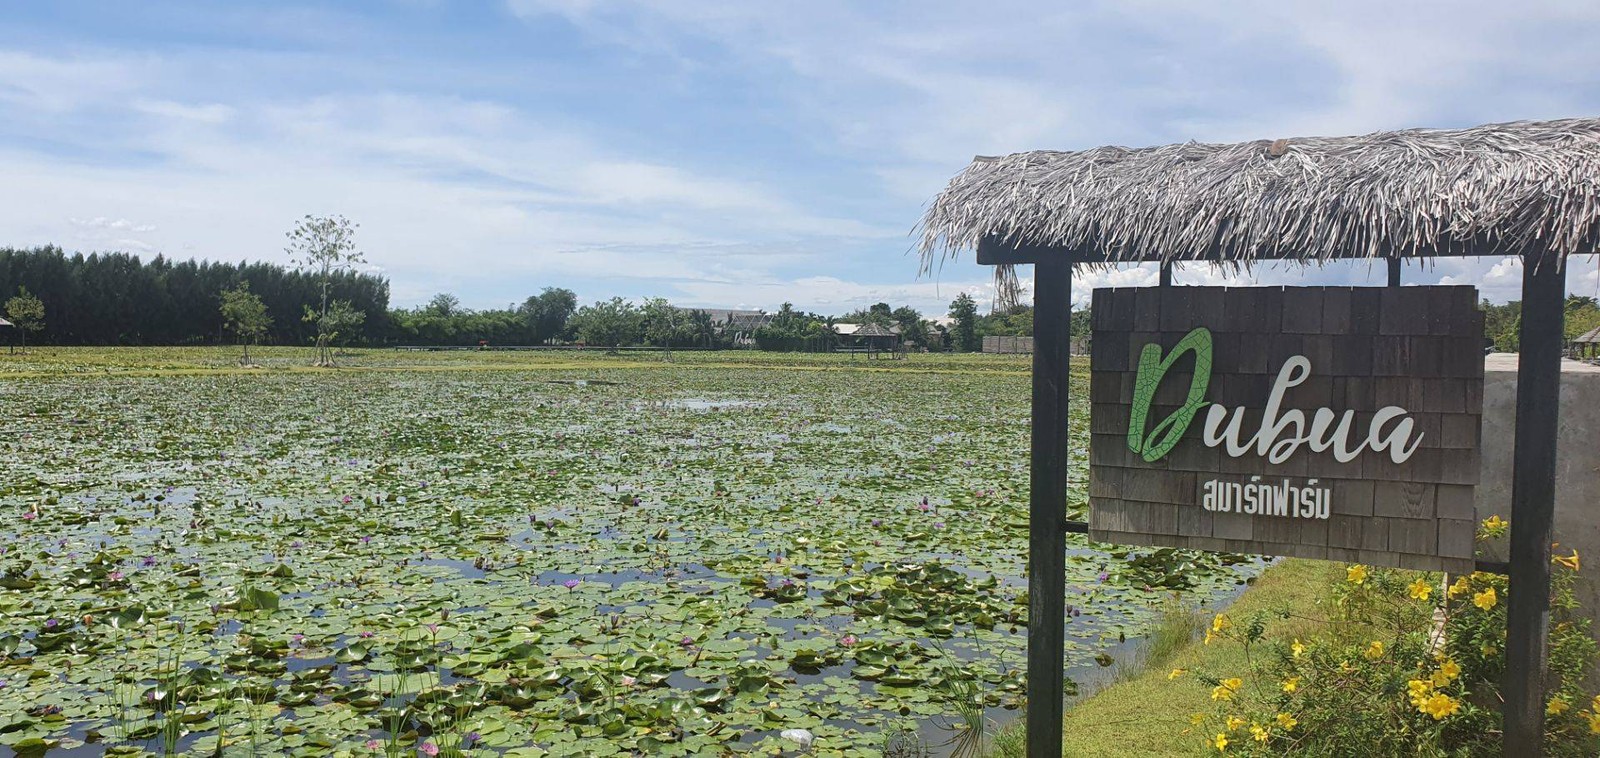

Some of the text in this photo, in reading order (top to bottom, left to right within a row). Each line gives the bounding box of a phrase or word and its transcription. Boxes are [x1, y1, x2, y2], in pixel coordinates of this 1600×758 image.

[1127, 327, 1424, 464] Dubua
[1203, 475, 1331, 520] สมาร์ทฟาร์ม
